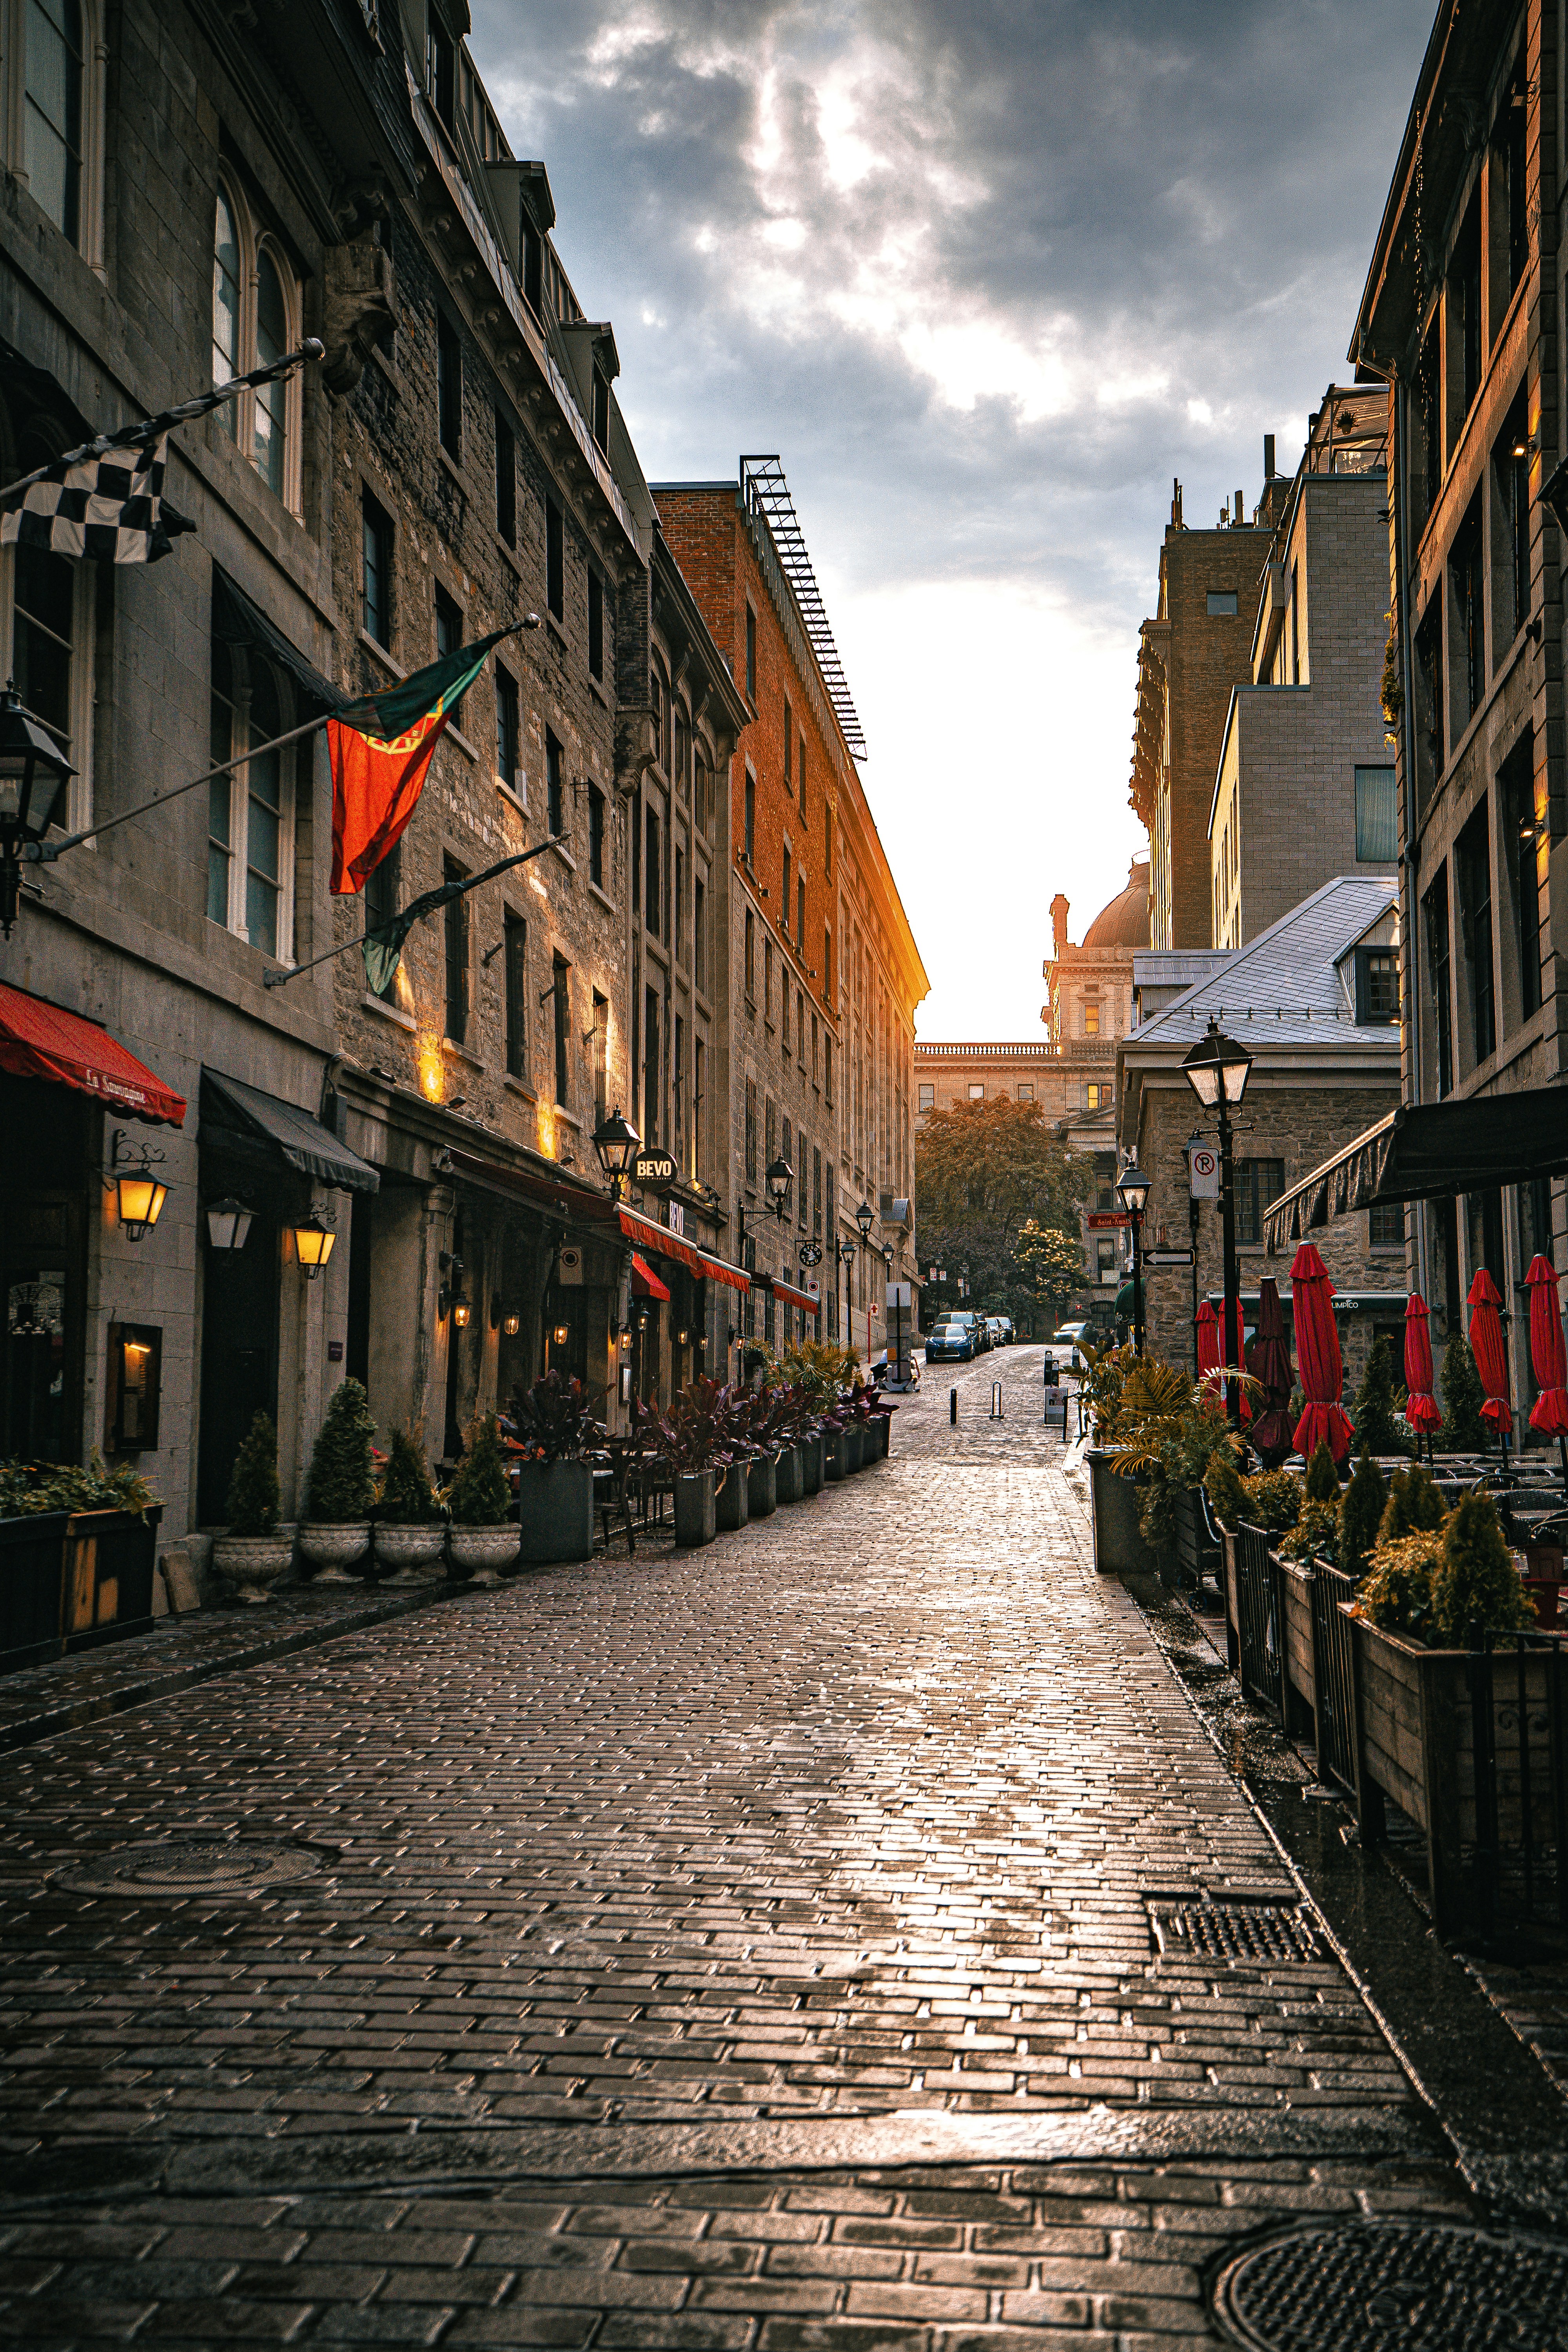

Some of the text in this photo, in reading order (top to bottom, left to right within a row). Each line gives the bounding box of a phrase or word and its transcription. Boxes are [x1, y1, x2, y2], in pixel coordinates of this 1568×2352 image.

[86, 1069, 99, 1087] La
[637, 1161, 671, 1176] BEVO
[670, 1200, 684, 1236] BEVO
[804, 1245, 820, 1255] BISOU
[801, 1255, 818, 1265] BISOU
